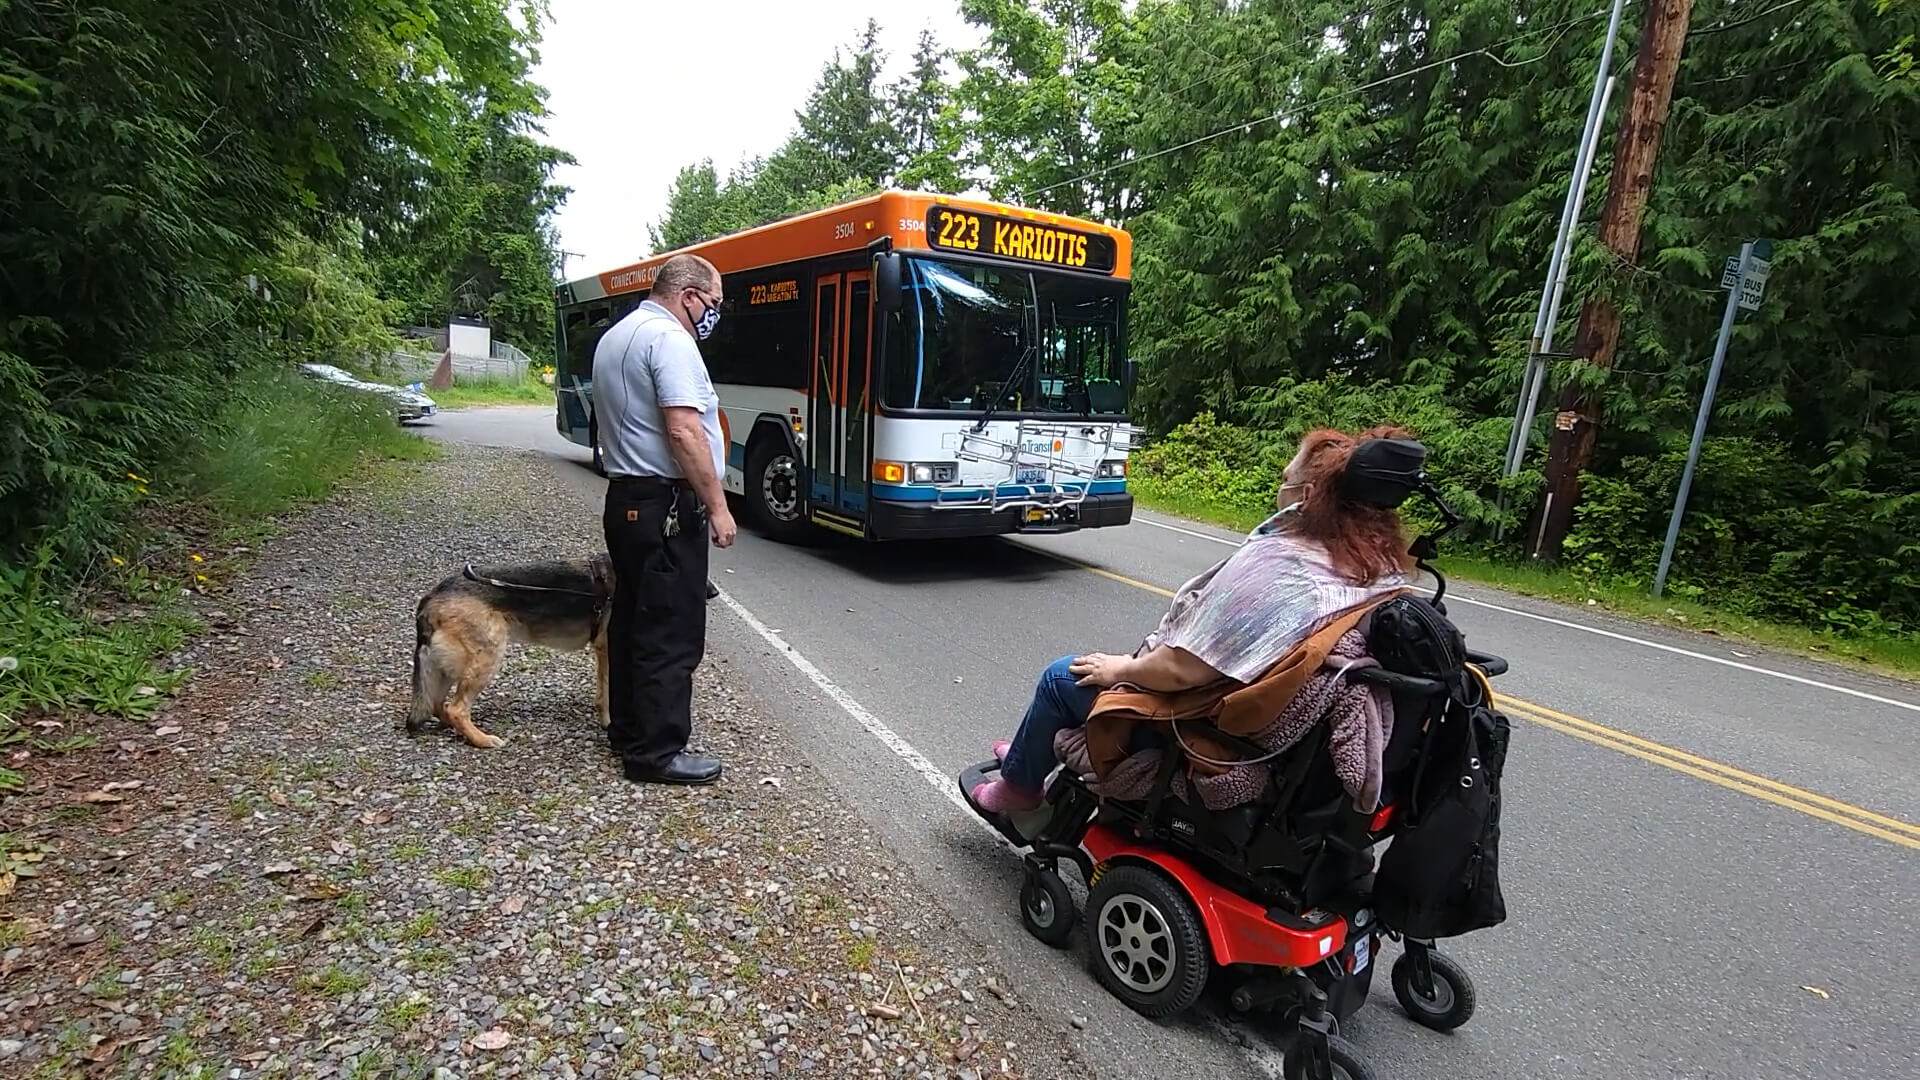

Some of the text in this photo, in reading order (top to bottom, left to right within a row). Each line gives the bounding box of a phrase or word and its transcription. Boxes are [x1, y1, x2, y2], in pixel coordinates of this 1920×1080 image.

[835, 221, 855, 240] 3504
[899, 219, 925, 232] 3504
[938, 211, 1087, 267] 223 KARIOTIS
[610, 267, 647, 290] CONNECTING
[1744, 278, 1762, 292] BUS
[750, 284, 767, 304] 223
[1739, 291, 1761, 305] STOP
